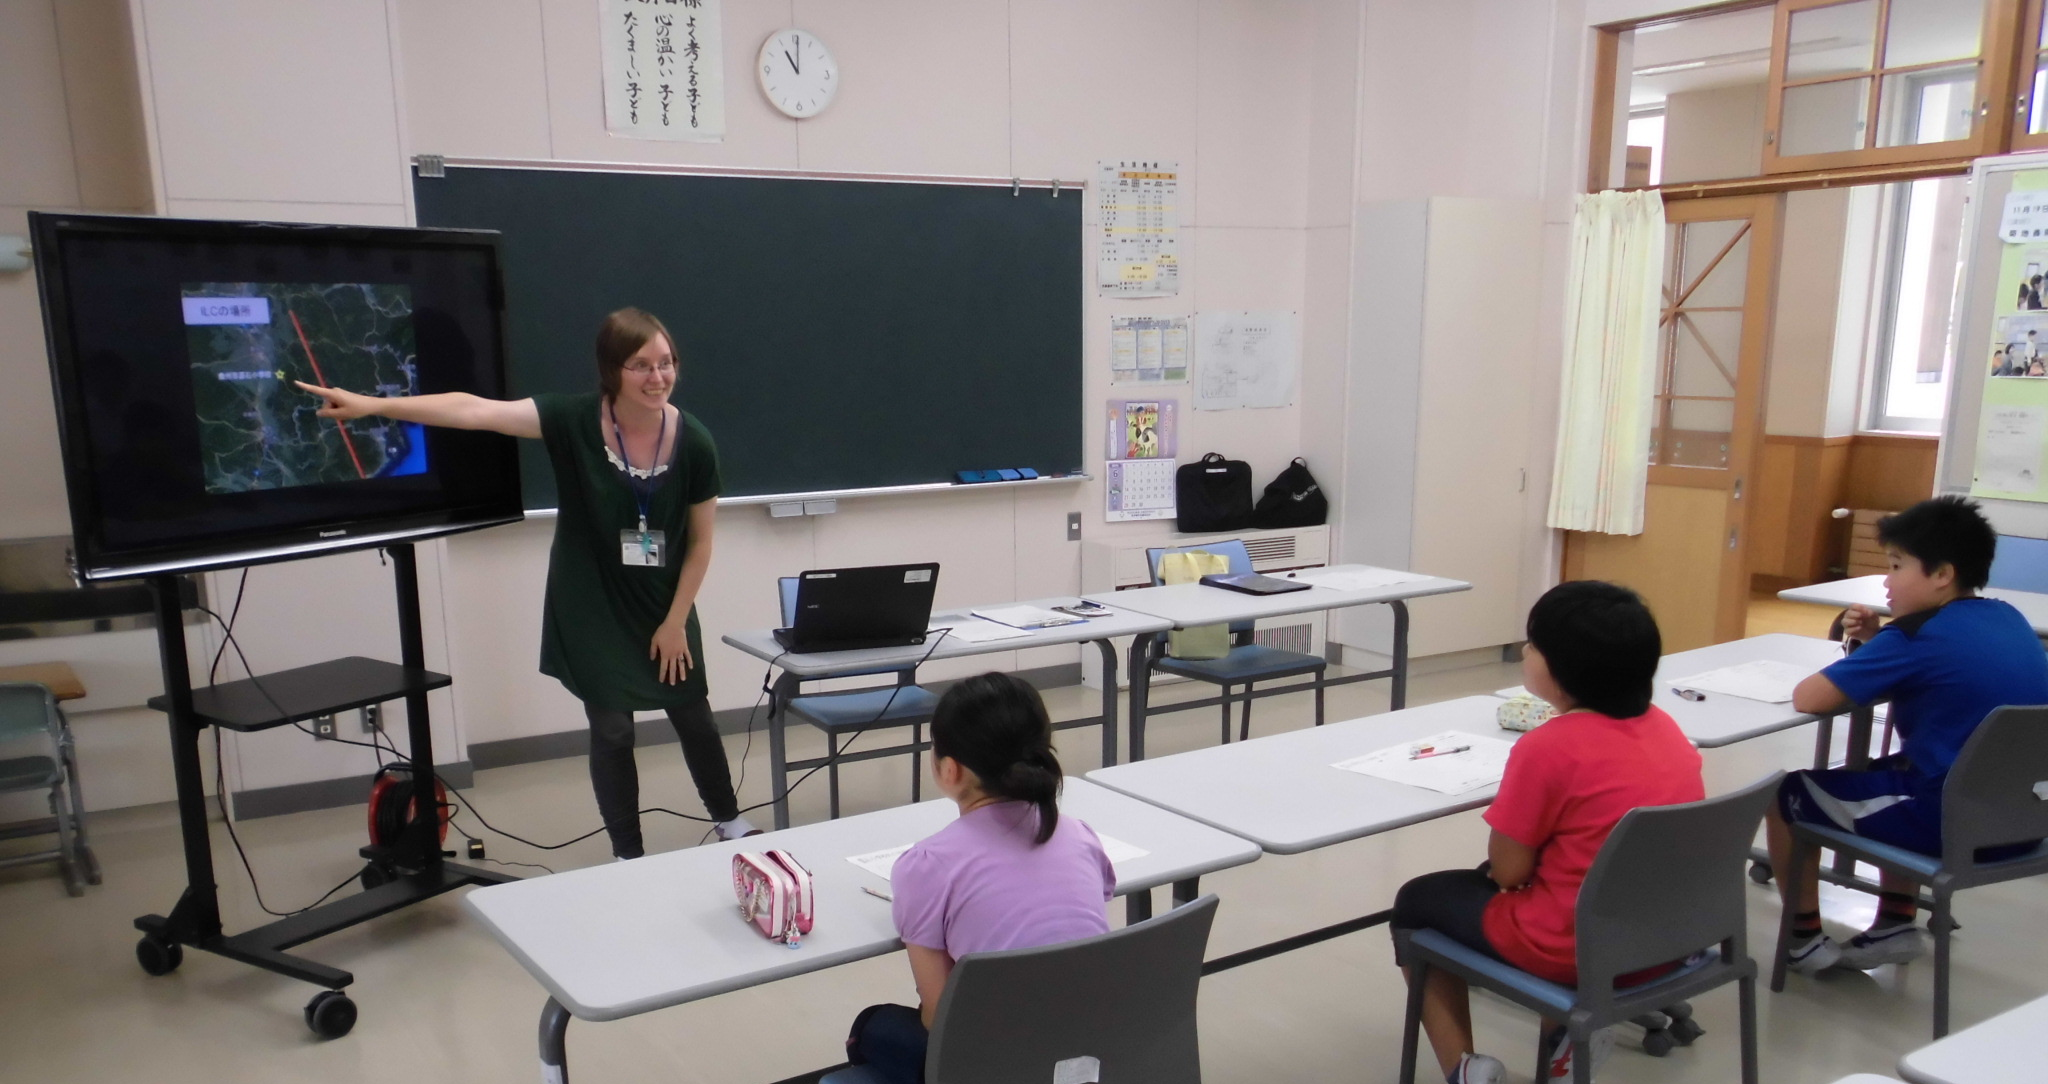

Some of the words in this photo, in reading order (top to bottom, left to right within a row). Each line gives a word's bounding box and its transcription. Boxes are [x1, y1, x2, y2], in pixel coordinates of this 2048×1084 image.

[623, 11, 643, 125] たくましい子ども
[655, 13, 676, 127] 心の温かい子ども
[684, 15, 701, 128] よく考える子ども
[764, 65, 771, 77] 9
[824, 69, 830, 81] 3
[796, 101, 803, 112] 6
